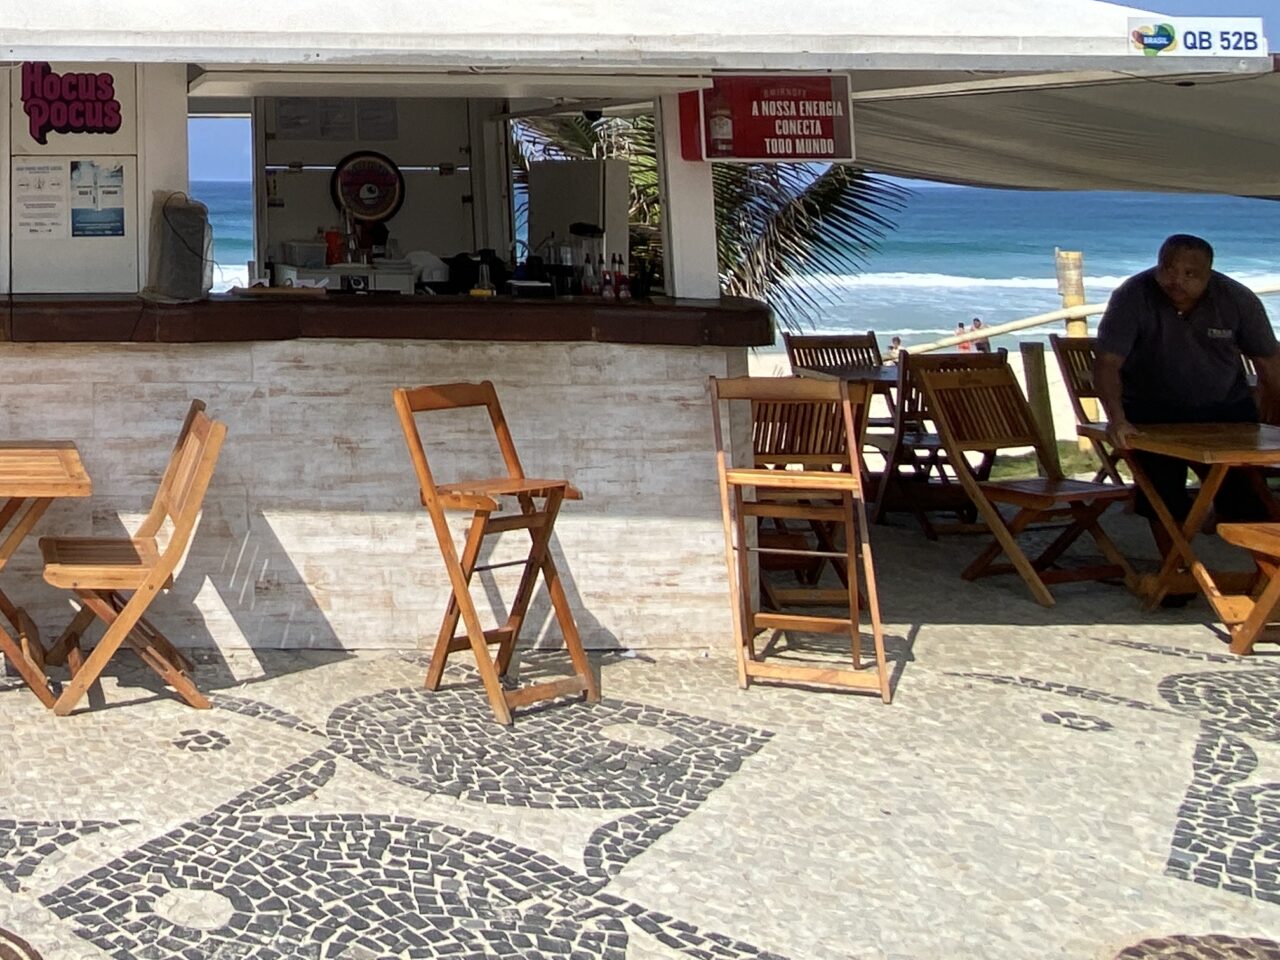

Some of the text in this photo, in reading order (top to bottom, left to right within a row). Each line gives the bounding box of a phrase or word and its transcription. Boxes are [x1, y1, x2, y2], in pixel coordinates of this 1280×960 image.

[1183, 31, 1259, 50] QB 52B
[752, 100, 843, 116] A NOSSA ENERGIA
[775, 120, 822, 135] CONECTA
[764, 138, 835, 154] TODO MUNDO
